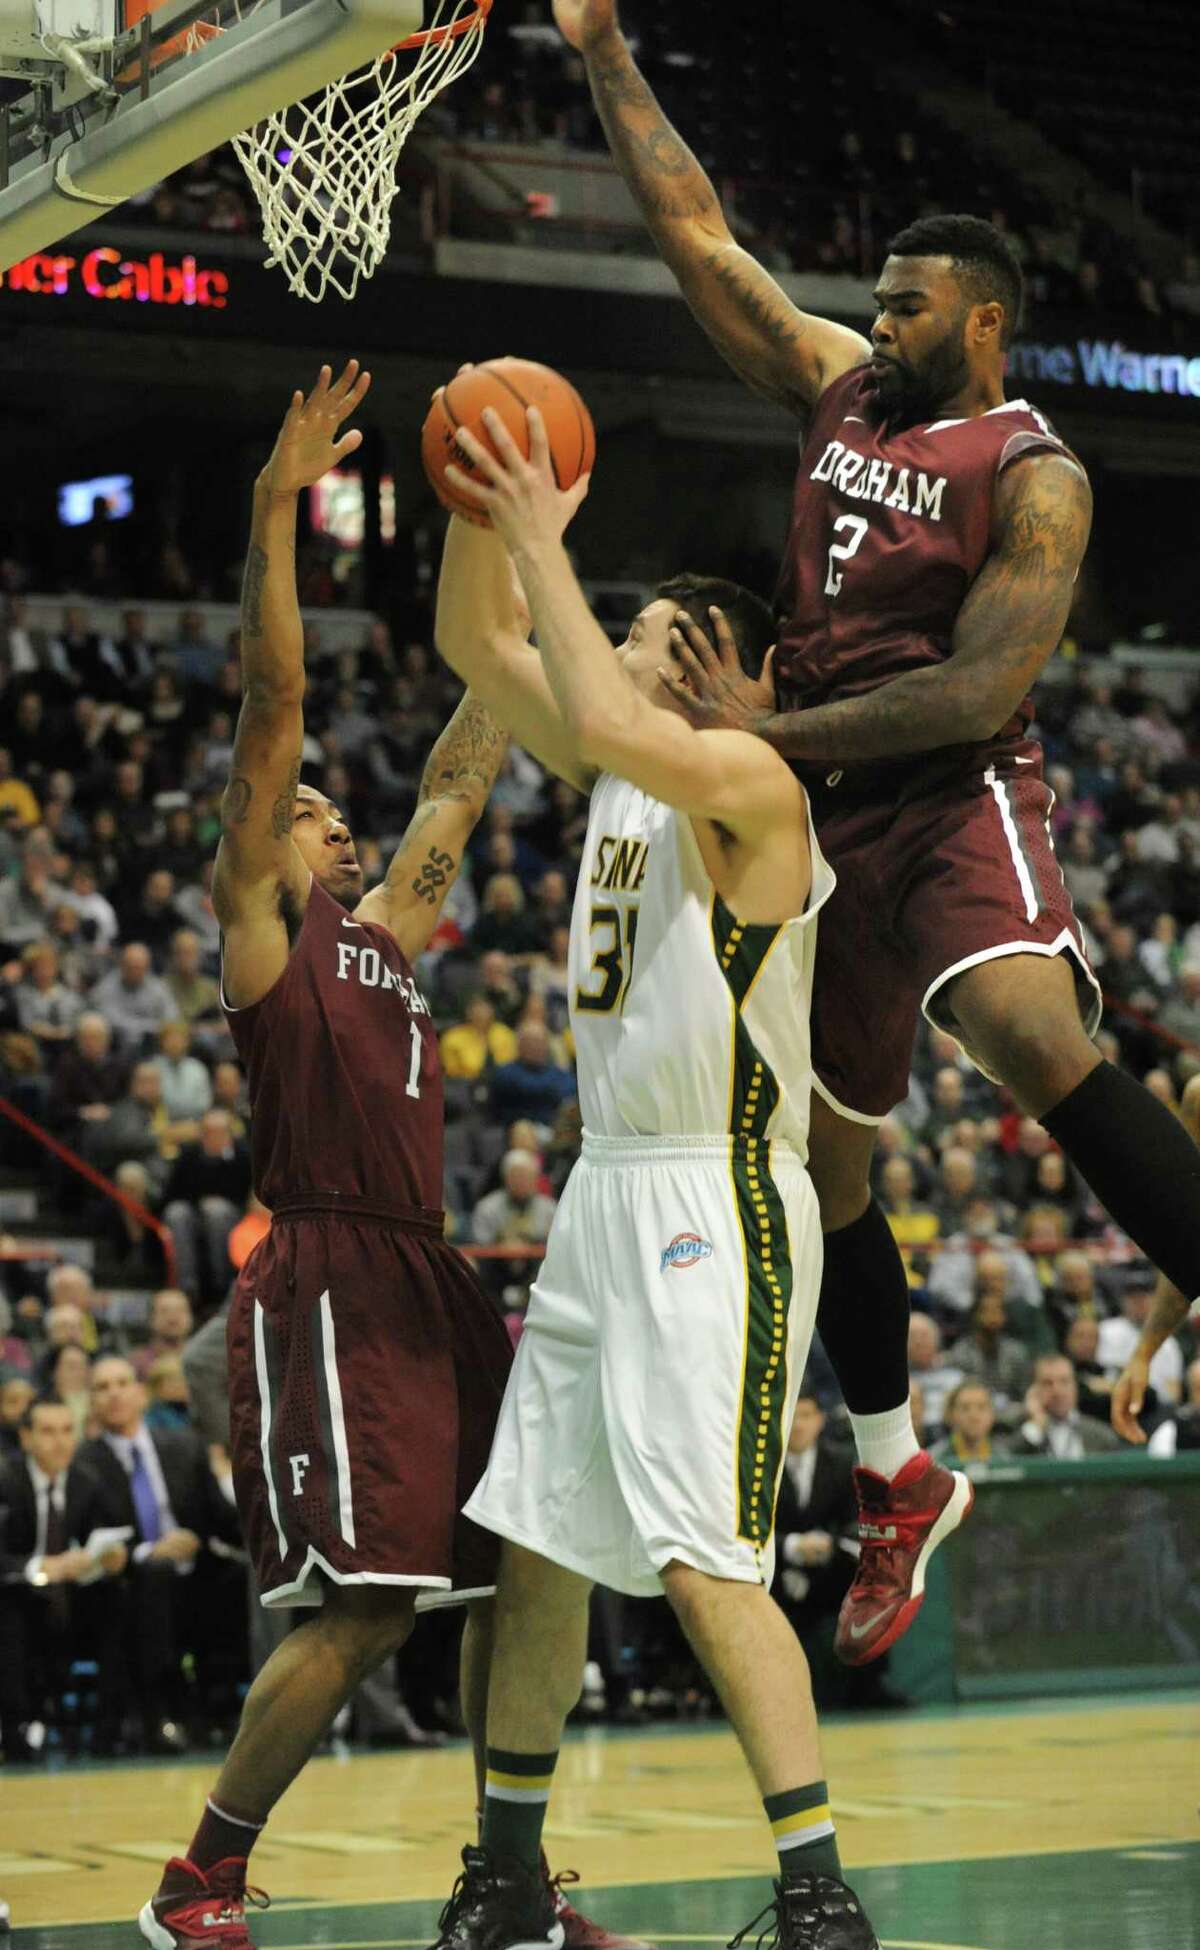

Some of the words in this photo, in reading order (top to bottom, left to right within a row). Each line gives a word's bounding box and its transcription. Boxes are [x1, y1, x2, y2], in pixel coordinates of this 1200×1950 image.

[82, 248, 229, 308] Cable
[824, 513, 869, 597] 2
[406, 1020, 422, 1099] 1
[289, 1453, 311, 1496] F
